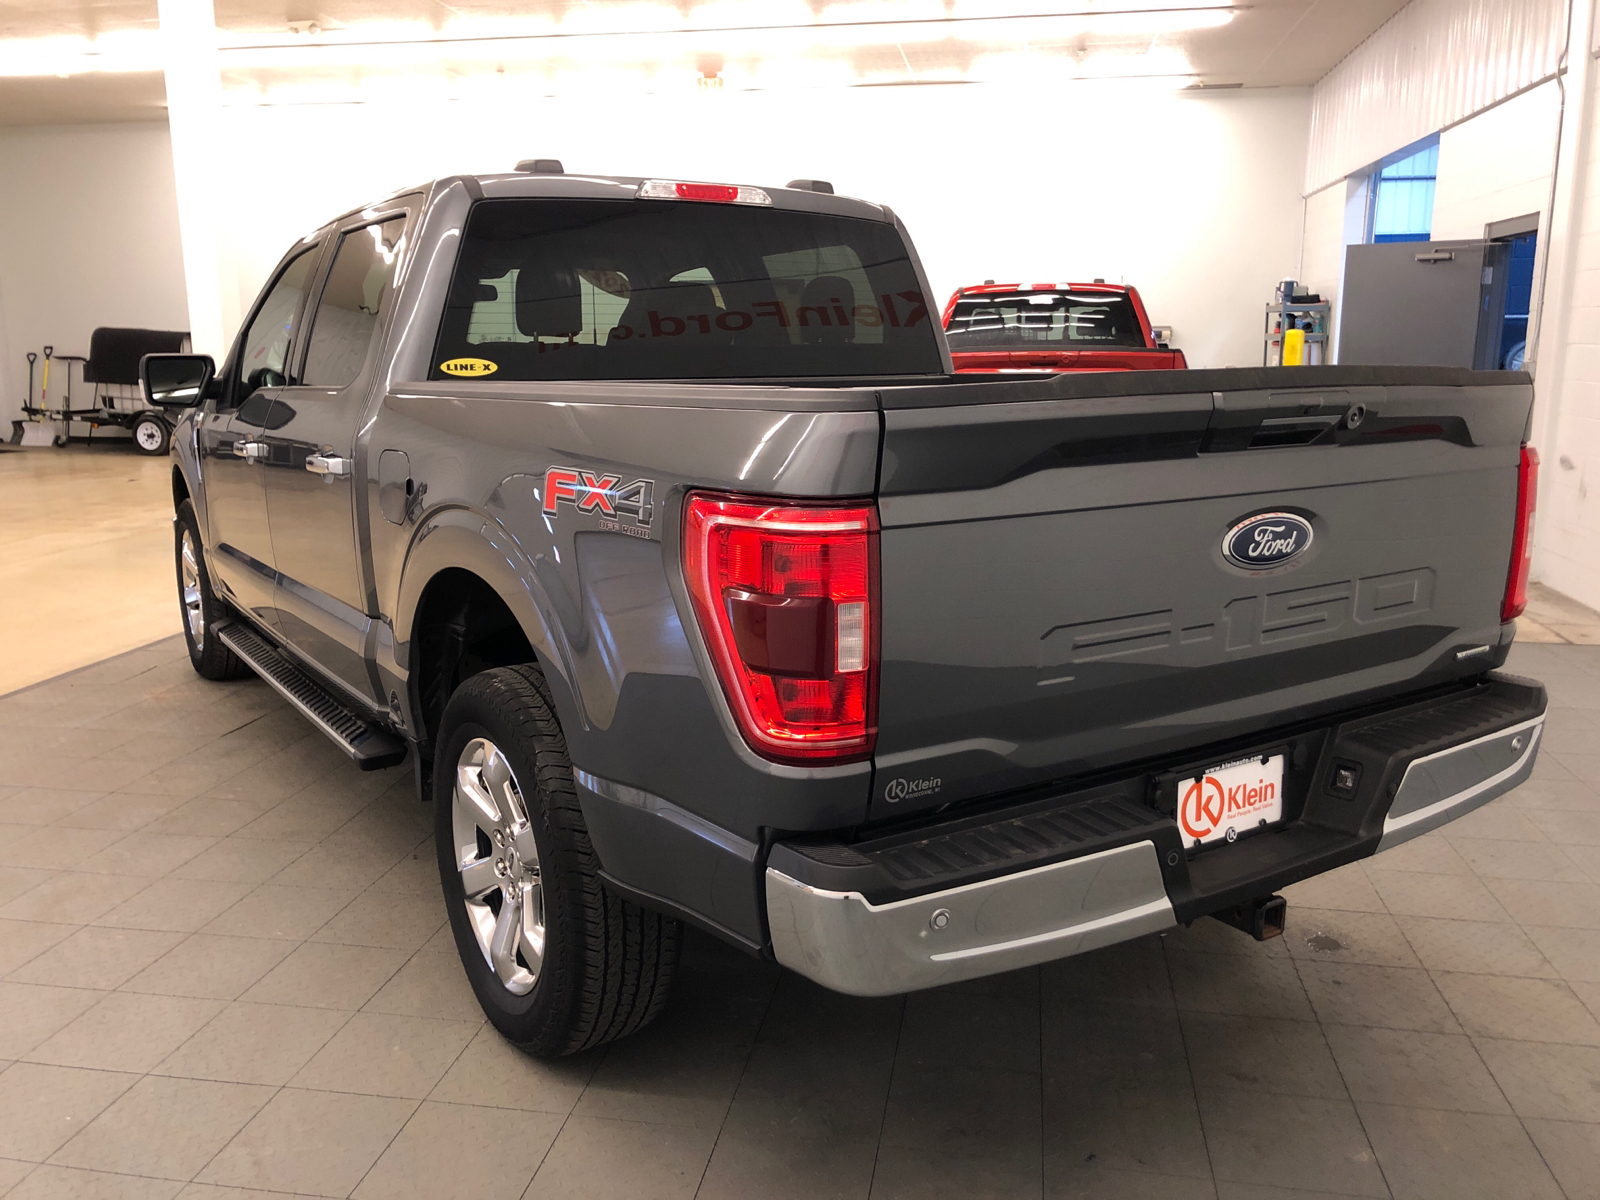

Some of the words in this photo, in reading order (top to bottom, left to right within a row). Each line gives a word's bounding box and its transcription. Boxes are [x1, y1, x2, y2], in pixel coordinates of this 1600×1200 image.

[446, 363, 491, 371] LINE-X
[541, 465, 654, 527] FX4
[599, 520, 619, 532] OFF
[622, 524, 651, 539] ROAD
[1248, 525, 1297, 557] Ford
[1036, 566, 1436, 686] F-150
[909, 777, 941, 792] Klein
[1228, 779, 1275, 812] Klein
